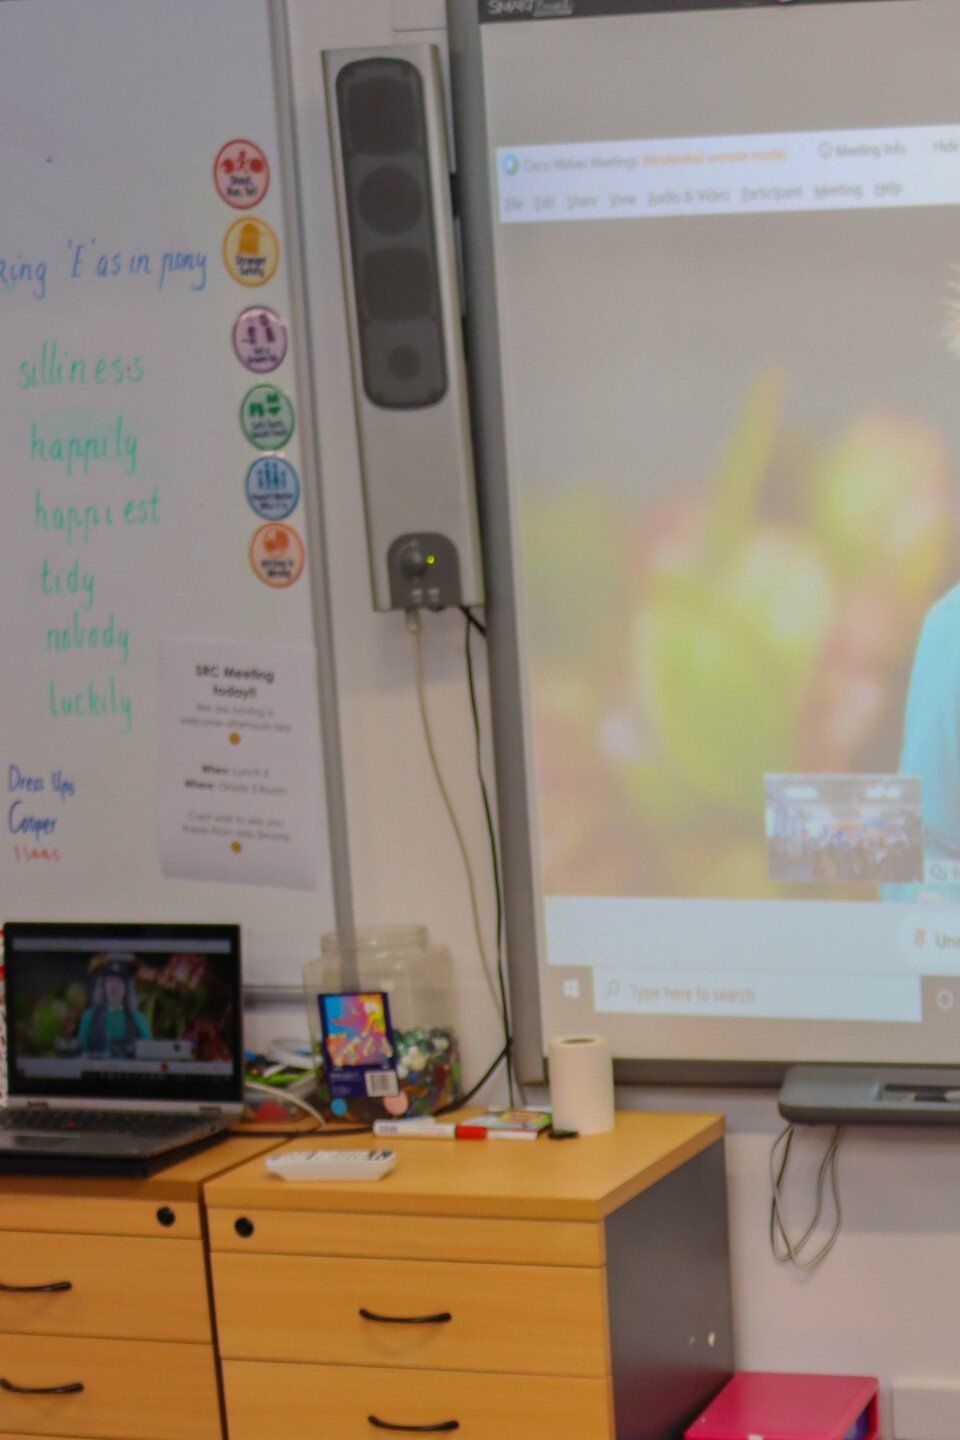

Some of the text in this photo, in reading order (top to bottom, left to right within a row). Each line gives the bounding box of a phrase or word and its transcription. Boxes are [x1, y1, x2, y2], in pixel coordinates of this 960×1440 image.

[836, 144, 881, 160] Meeting
[129, 252, 151, 274] in
[157, 251, 208, 292] pony
[18, 336, 145, 390] silliness
[31, 415, 139, 477] happily
[34, 485, 161, 546] happiest
[41, 558, 95, 612] tidy
[47, 607, 130, 667] nobody
[223, 666, 275, 685] Meeting
